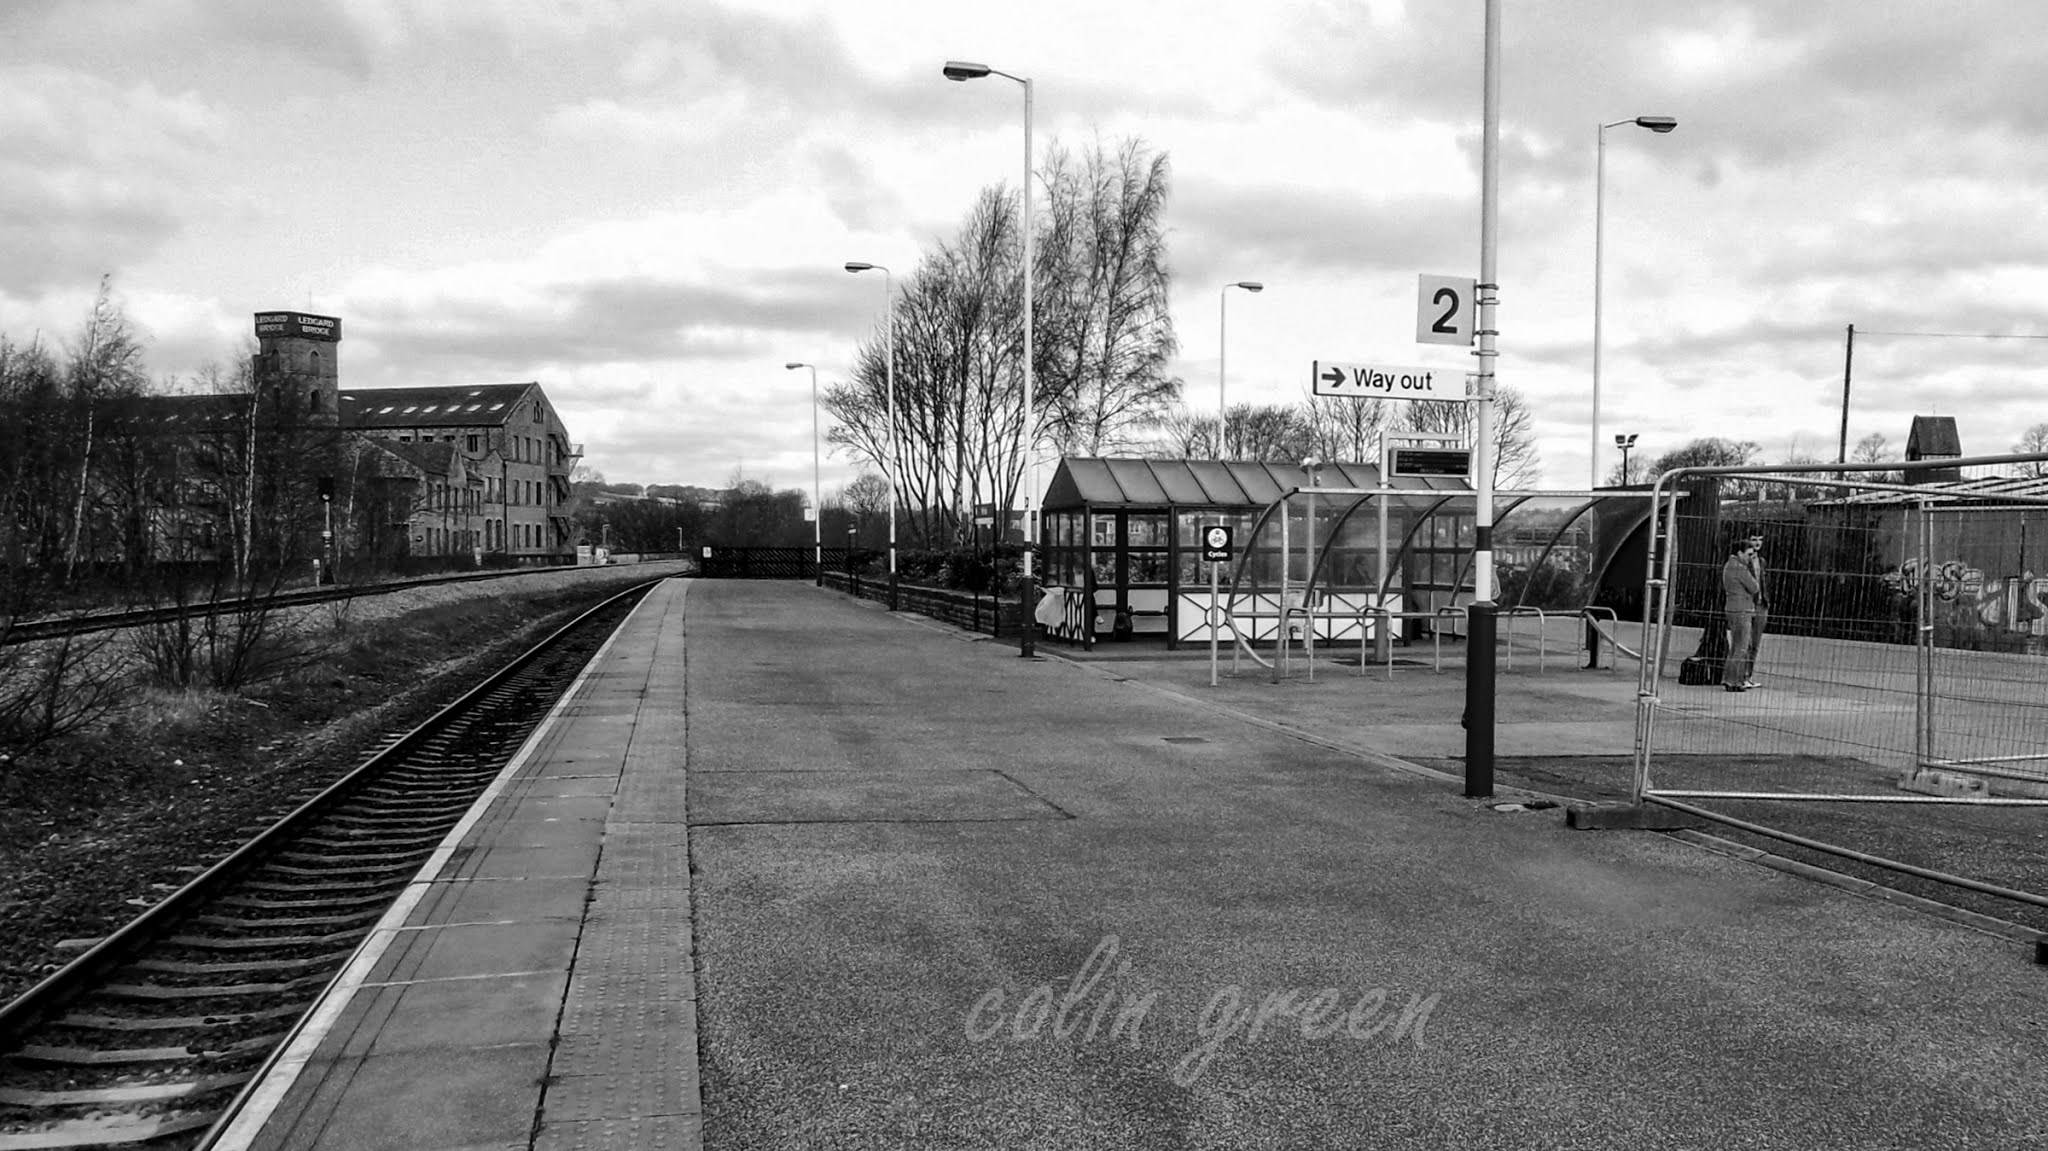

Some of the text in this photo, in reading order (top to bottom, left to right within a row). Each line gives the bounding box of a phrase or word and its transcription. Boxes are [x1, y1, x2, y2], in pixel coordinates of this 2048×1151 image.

[1432, 287, 1460, 334] 2
[256, 315, 288, 324] LEDGARD
[298, 316, 334, 328] LEDGARD
[302, 325, 330, 336] BRIDGE
[1353, 368, 1433, 392] Way out
[1208, 550, 1228, 559] Cycles
